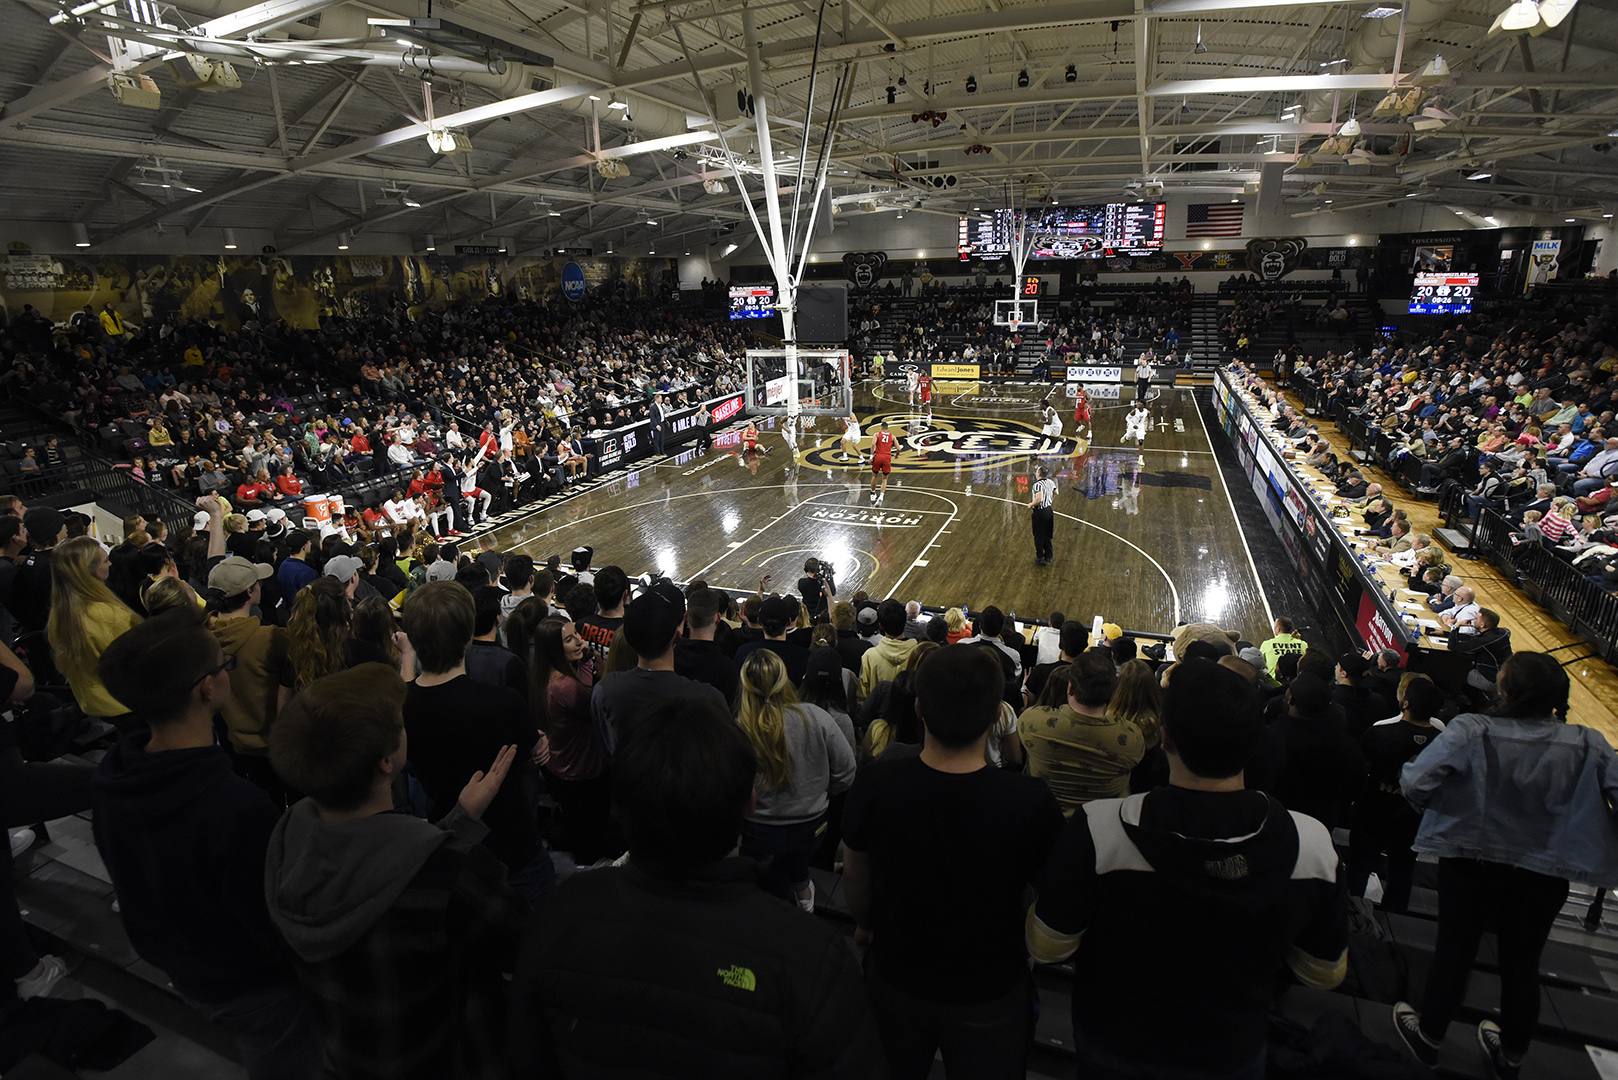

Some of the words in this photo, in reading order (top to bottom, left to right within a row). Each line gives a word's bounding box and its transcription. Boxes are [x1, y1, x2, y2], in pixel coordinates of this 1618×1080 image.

[1411, 236, 1462, 244] CONCESSIONS
[1534, 241, 1559, 250] MILK
[1173, 252, 1202, 270] Y
[1329, 254, 1346, 262] BOLD
[565, 280, 584, 291] NCAA
[1025, 283, 1038, 295] 20
[1417, 286, 1434, 297] 20
[1453, 286, 1472, 297] 20
[733, 297, 745, 306] 20
[759, 296, 770, 305] 20
[957, 366, 975, 374] Jones
[715, 398, 741, 422] BASELINE
[672, 420, 677, 434] 8
[881, 434, 890, 444] 21
[811, 510, 922, 526] HORIZON
[717, 968, 744, 981] NORTH
[731, 964, 746, 975] THE
[723, 976, 744, 990] FACE
